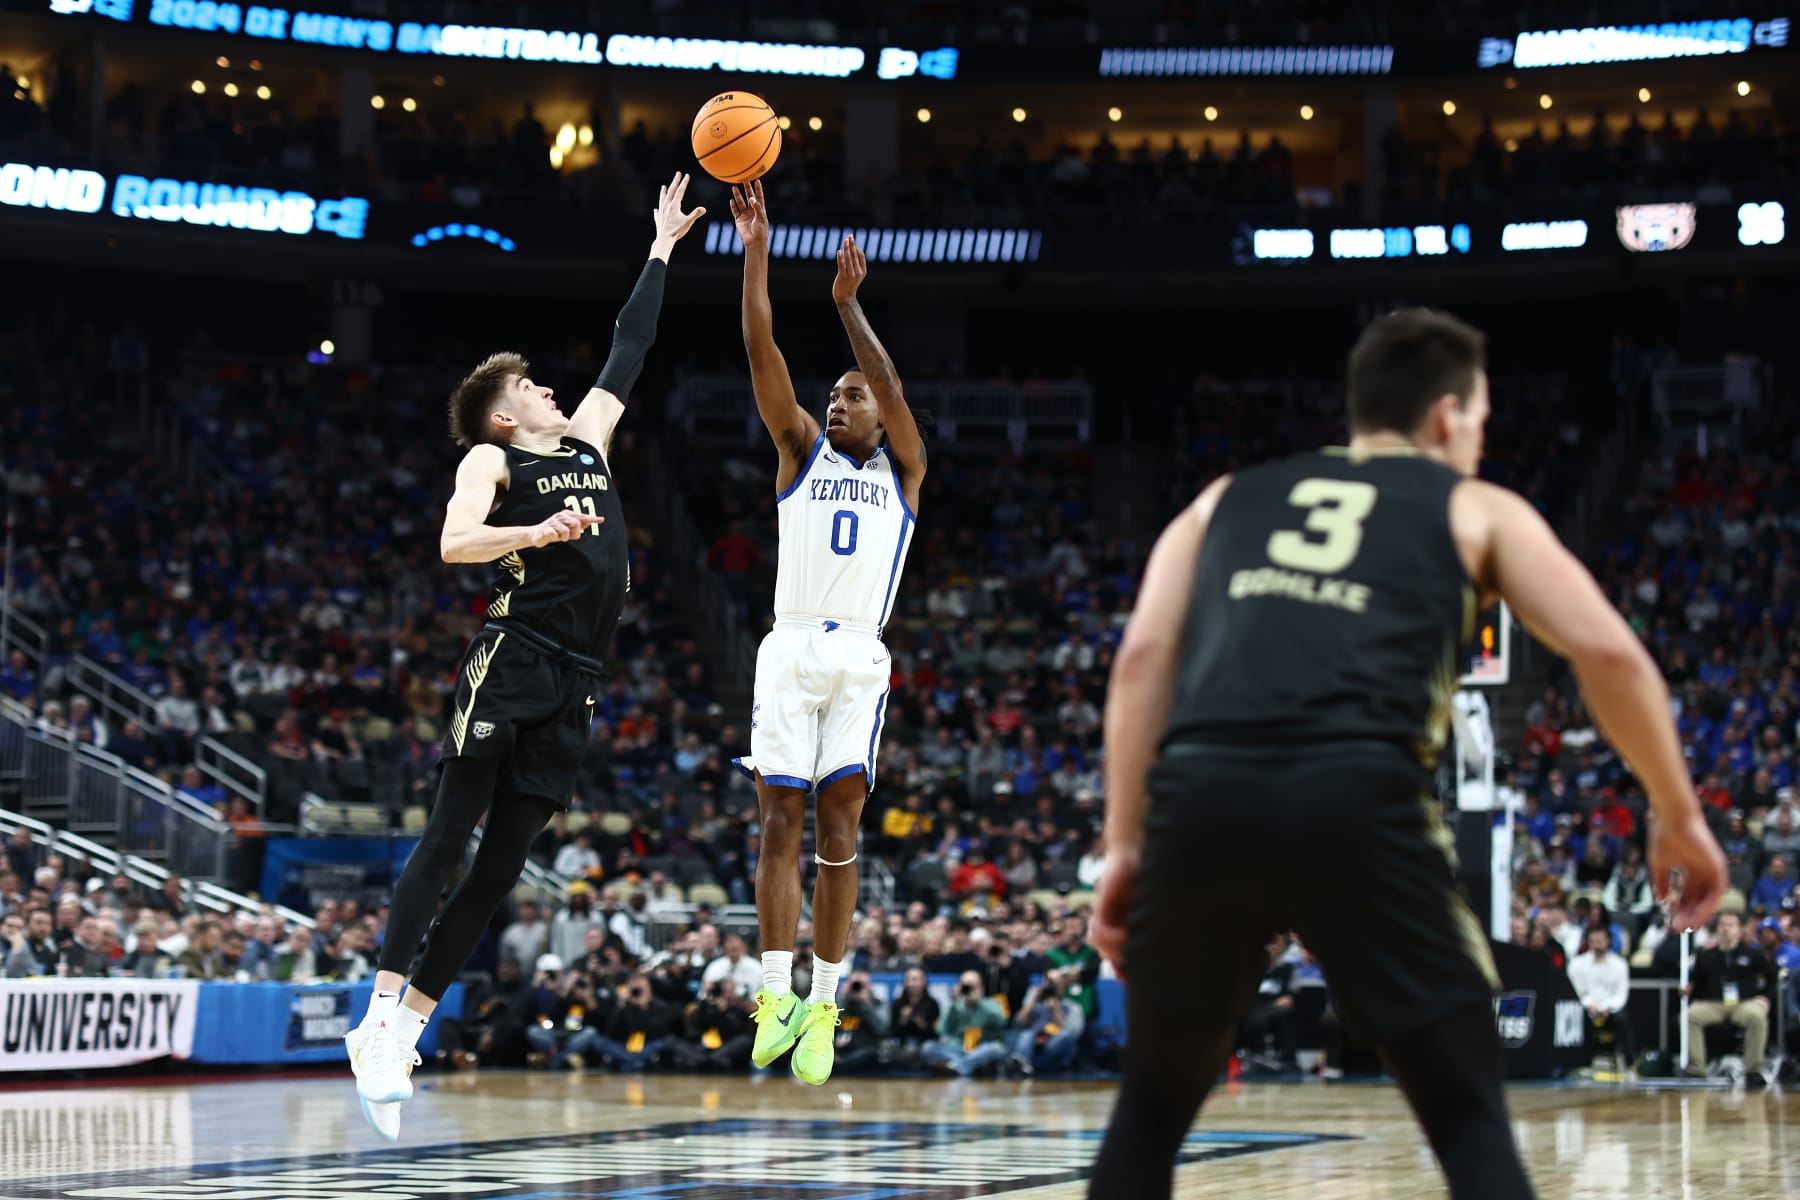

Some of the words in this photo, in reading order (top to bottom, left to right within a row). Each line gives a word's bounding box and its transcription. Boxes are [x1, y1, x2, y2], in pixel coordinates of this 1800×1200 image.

[150, 0, 242, 33] 2024
[291, 11, 393, 51] MEN'S
[396, 22, 603, 64] BASKETBALL
[606, 34, 865, 77] CHAMPIONSHIP
[111, 174, 316, 234] ROUNDS
[536, 472, 608, 495] OAKLAND
[811, 478, 889, 511] KENTUCKY
[831, 509, 859, 556] 0
[1266, 477, 1379, 575] 3
[3, 992, 183, 1053] UNIVERSITY
